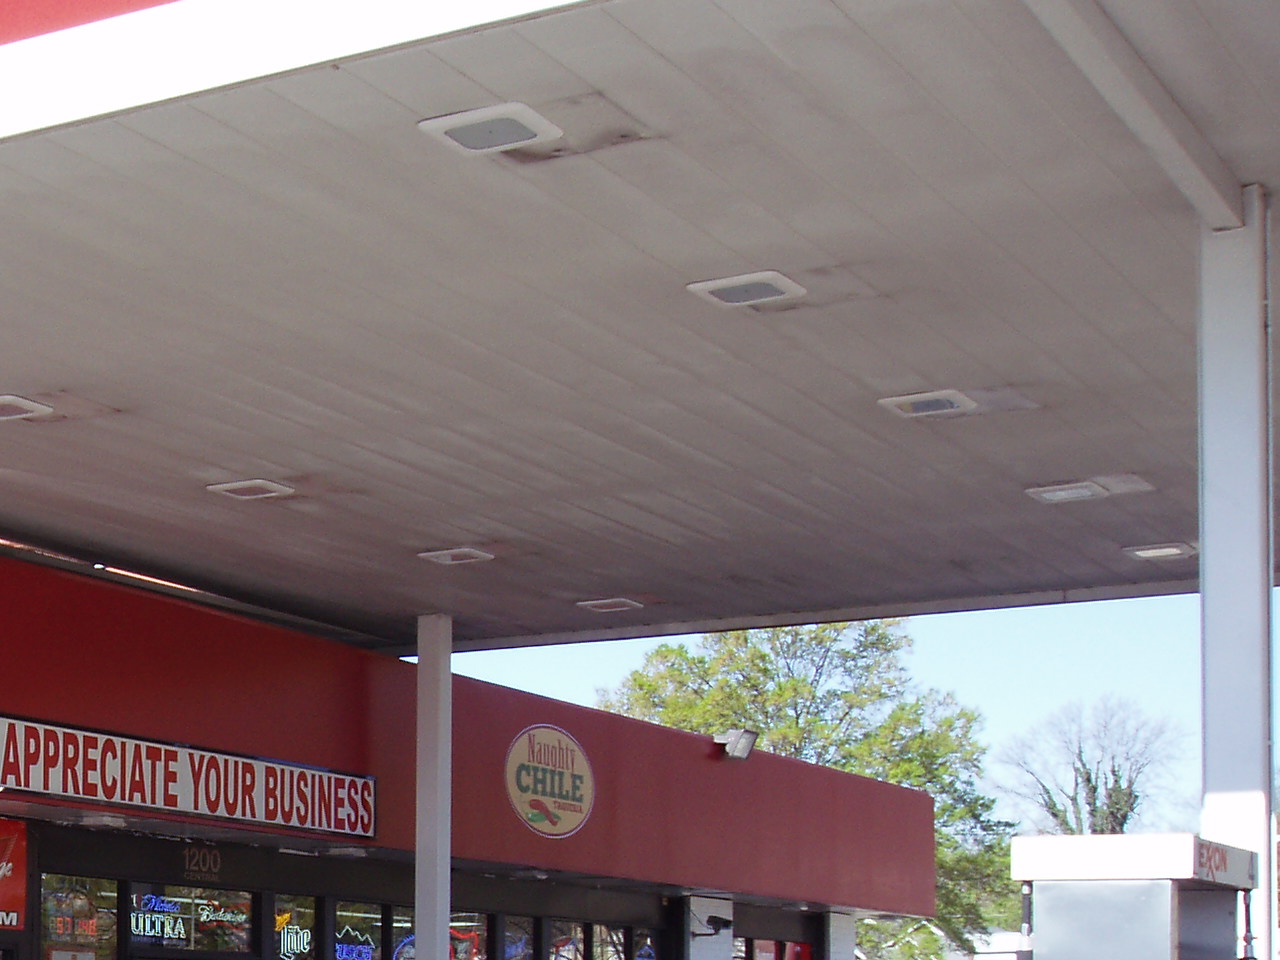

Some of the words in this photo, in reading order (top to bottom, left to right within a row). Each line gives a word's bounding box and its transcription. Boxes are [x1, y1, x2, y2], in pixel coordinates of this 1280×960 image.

[528, 733, 576, 773] Naughty
[0, 722, 178, 808] APPRECIATE
[188, 752, 257, 819] YOUR
[264, 765, 372, 834] BUSINESS
[516, 763, 584, 803] CHILE
[183, 847, 221, 873] 1200
[130, 912, 187, 939] ULTRA
